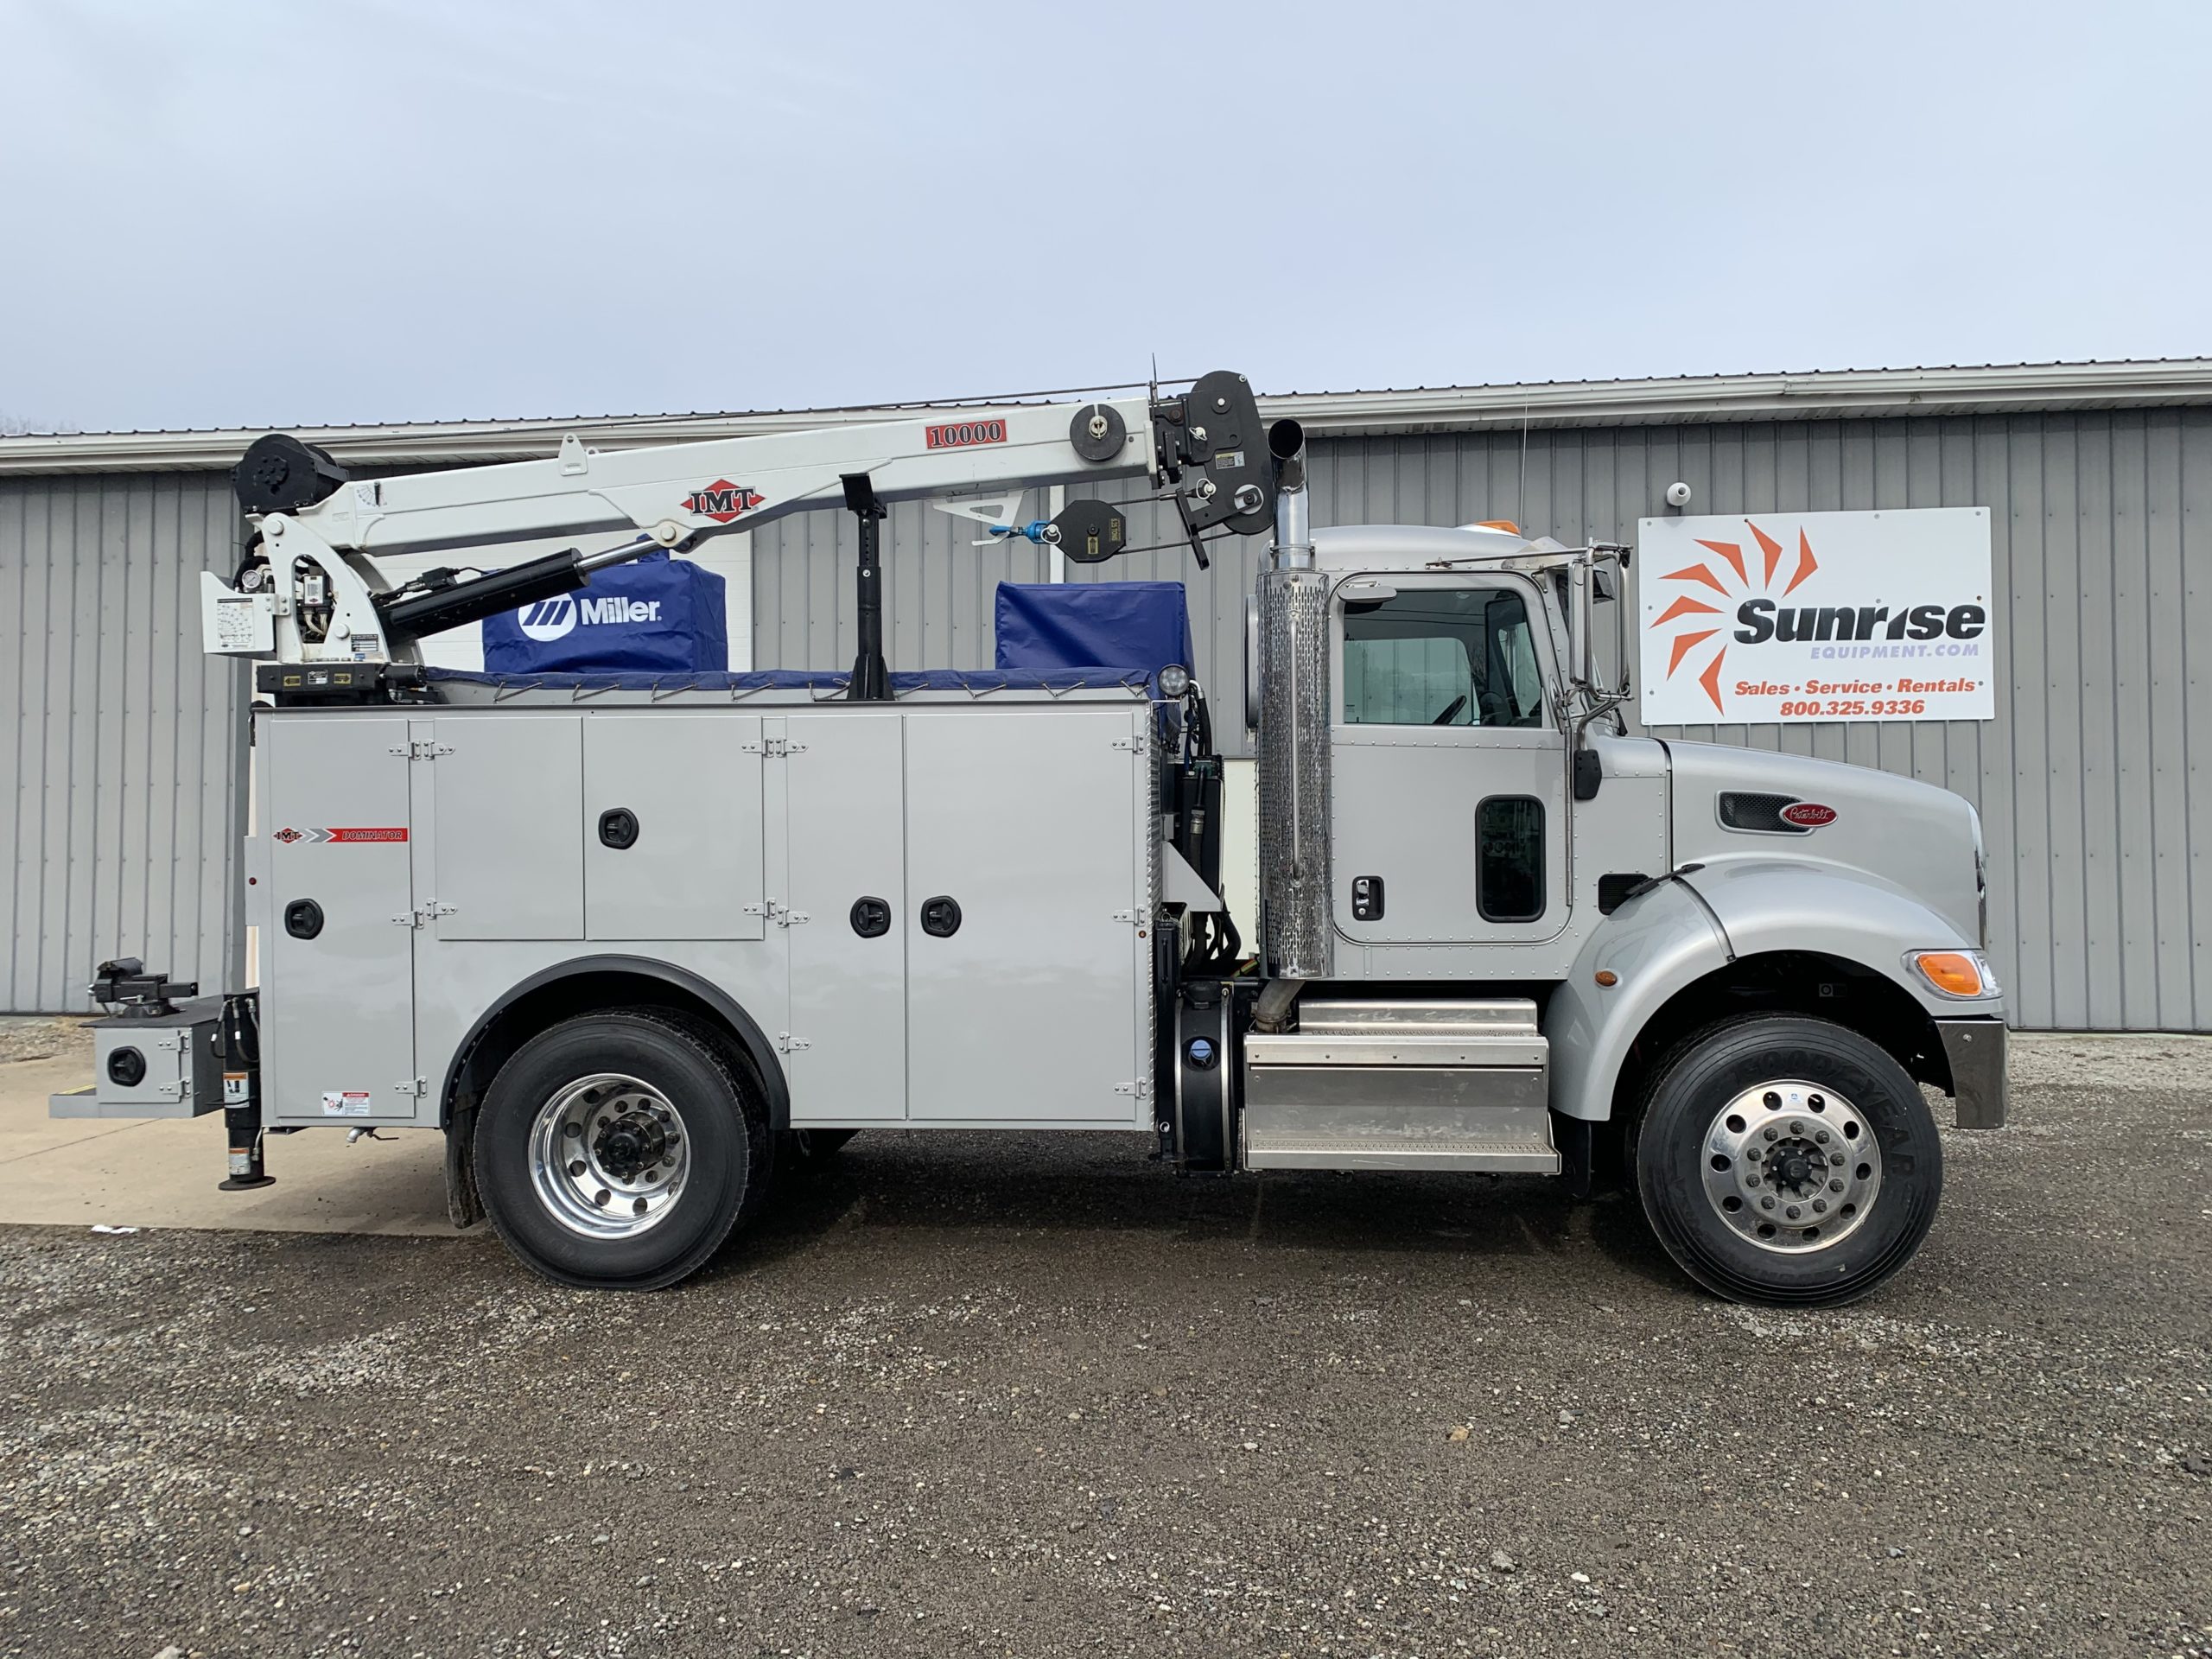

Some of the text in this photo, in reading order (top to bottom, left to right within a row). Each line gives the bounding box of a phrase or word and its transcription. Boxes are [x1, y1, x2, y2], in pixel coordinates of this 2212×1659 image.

[931, 422, 1002, 448] 10000
[690, 486, 756, 516] IMT
[580, 597, 661, 625] Miller
[1734, 598, 1986, 645] Sunrise
[1810, 644, 1979, 659] EQUIPMENT.COM
[1735, 677, 1976, 696] Sales Service Rentals
[1780, 700, 1925, 716] 800.325.9336
[276, 831, 403, 841] IMT DOMINATOR
